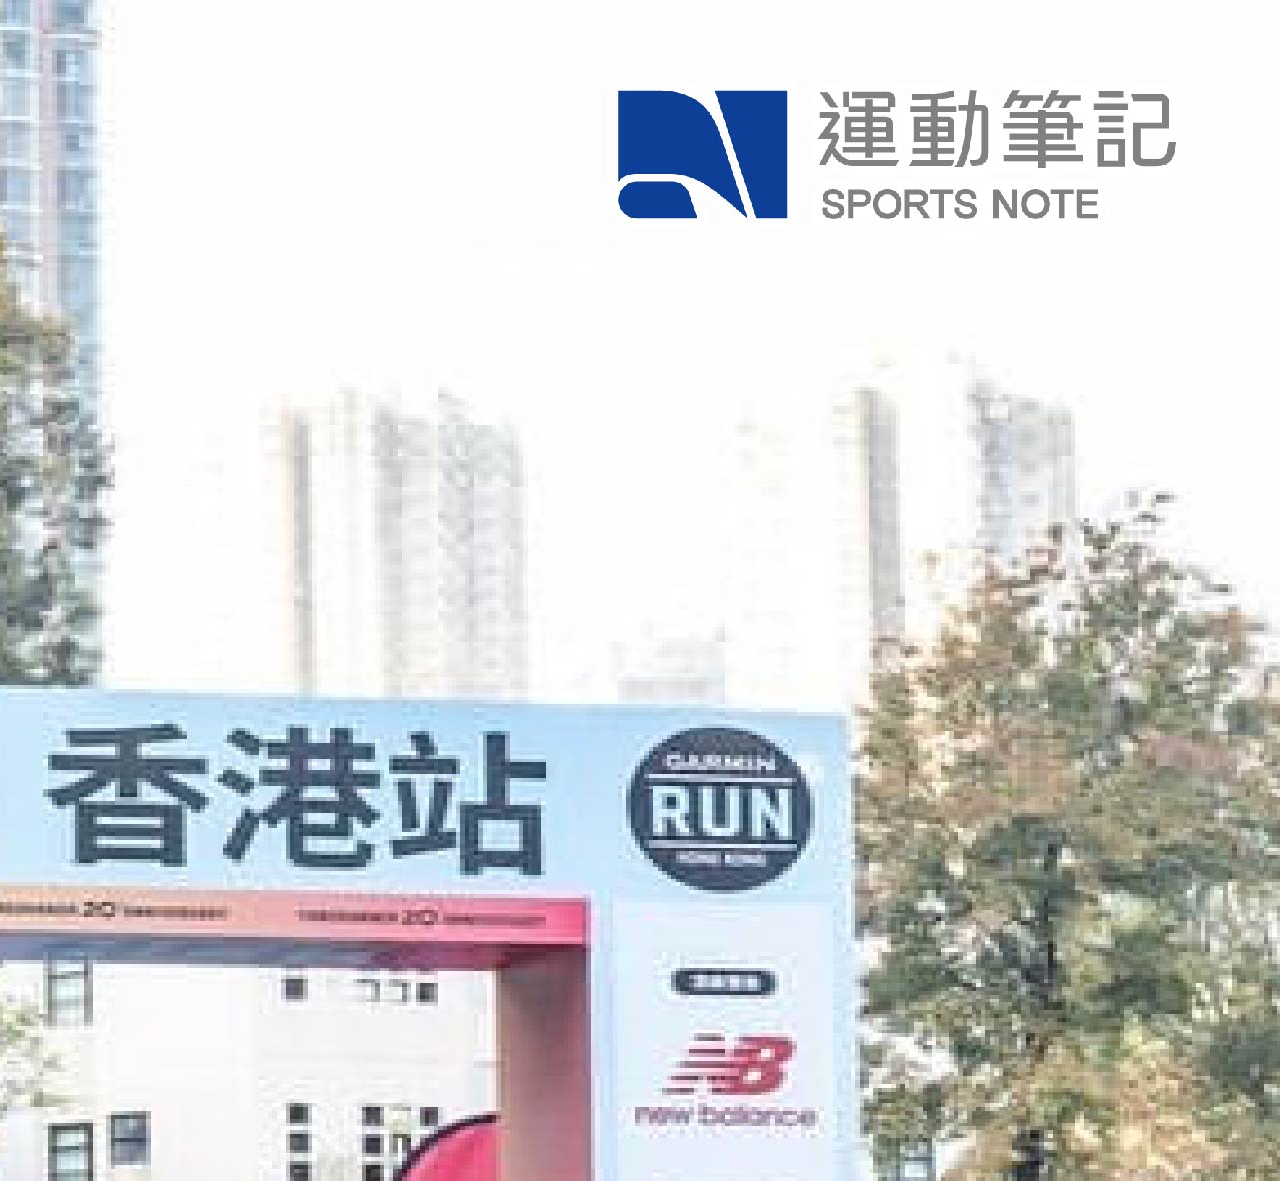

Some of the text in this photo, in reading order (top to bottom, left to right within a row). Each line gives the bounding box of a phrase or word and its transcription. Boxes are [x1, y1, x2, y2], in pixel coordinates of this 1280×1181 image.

[43, 723, 547, 876] 香港站
[650, 785, 793, 840] RUN
[634, 1104, 818, 1127] new balance
